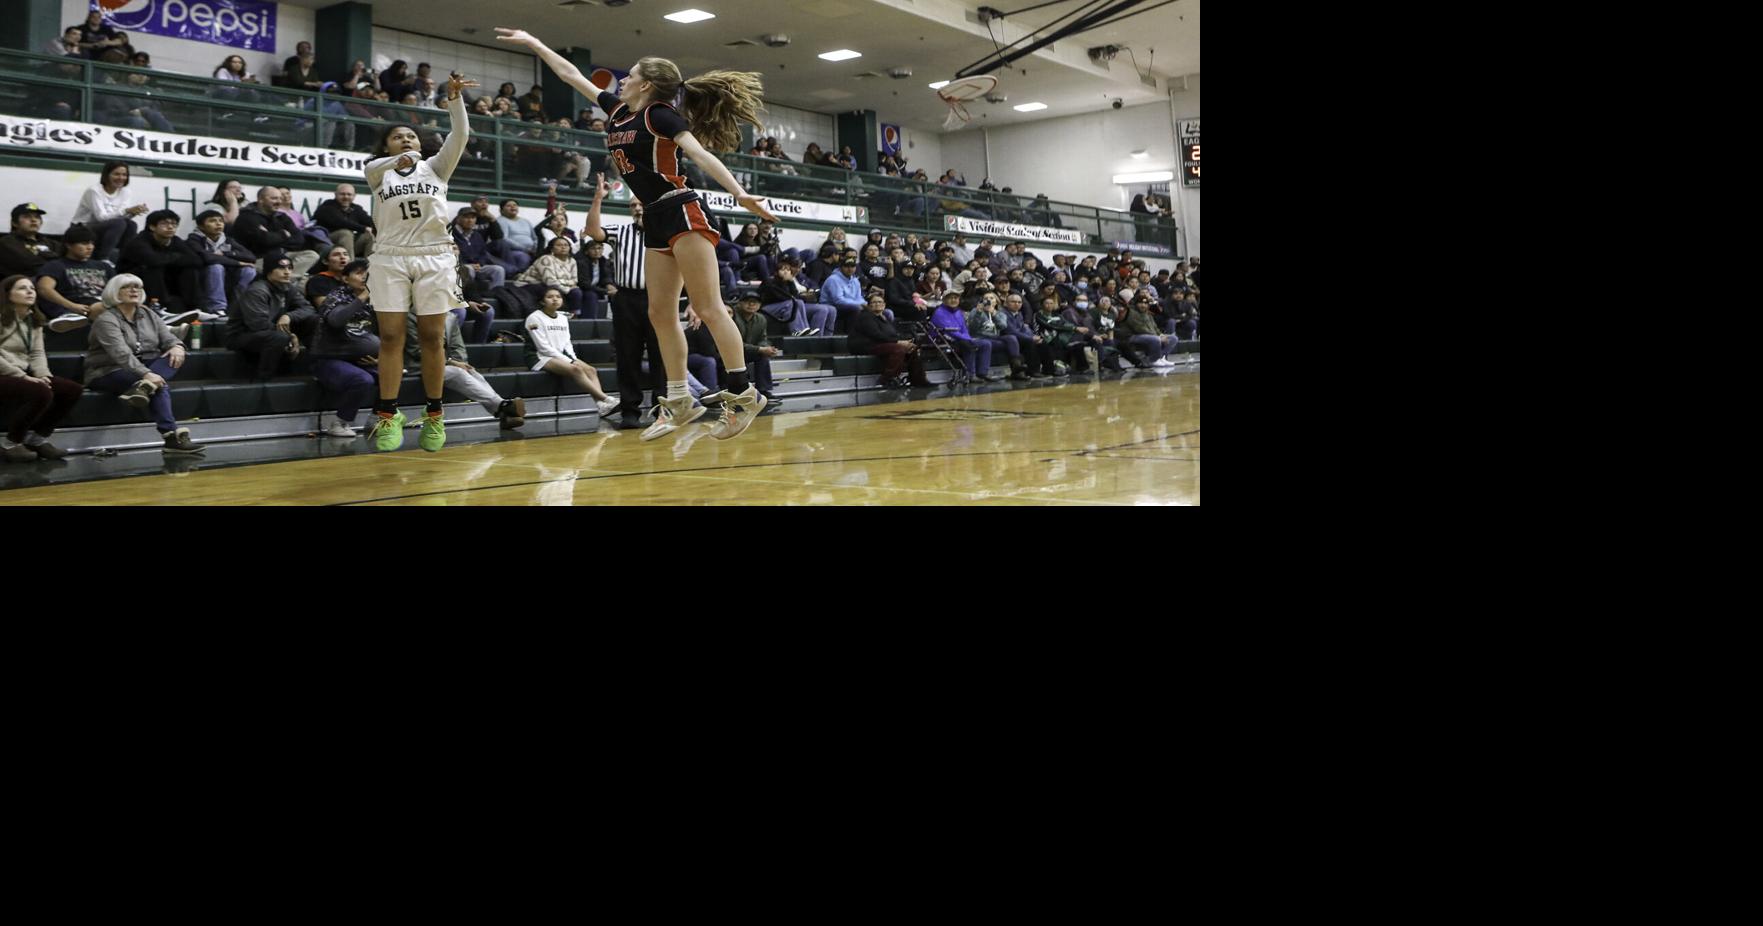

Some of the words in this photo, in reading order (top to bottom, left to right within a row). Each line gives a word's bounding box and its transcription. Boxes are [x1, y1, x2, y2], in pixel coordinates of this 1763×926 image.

[161, 0, 268, 37] pepsi
[114, 131, 250, 161] Student
[378, 177, 440, 203] FLAGSTAFF
[398, 200, 422, 221] 15
[969, 220, 1004, 235] Visiting
